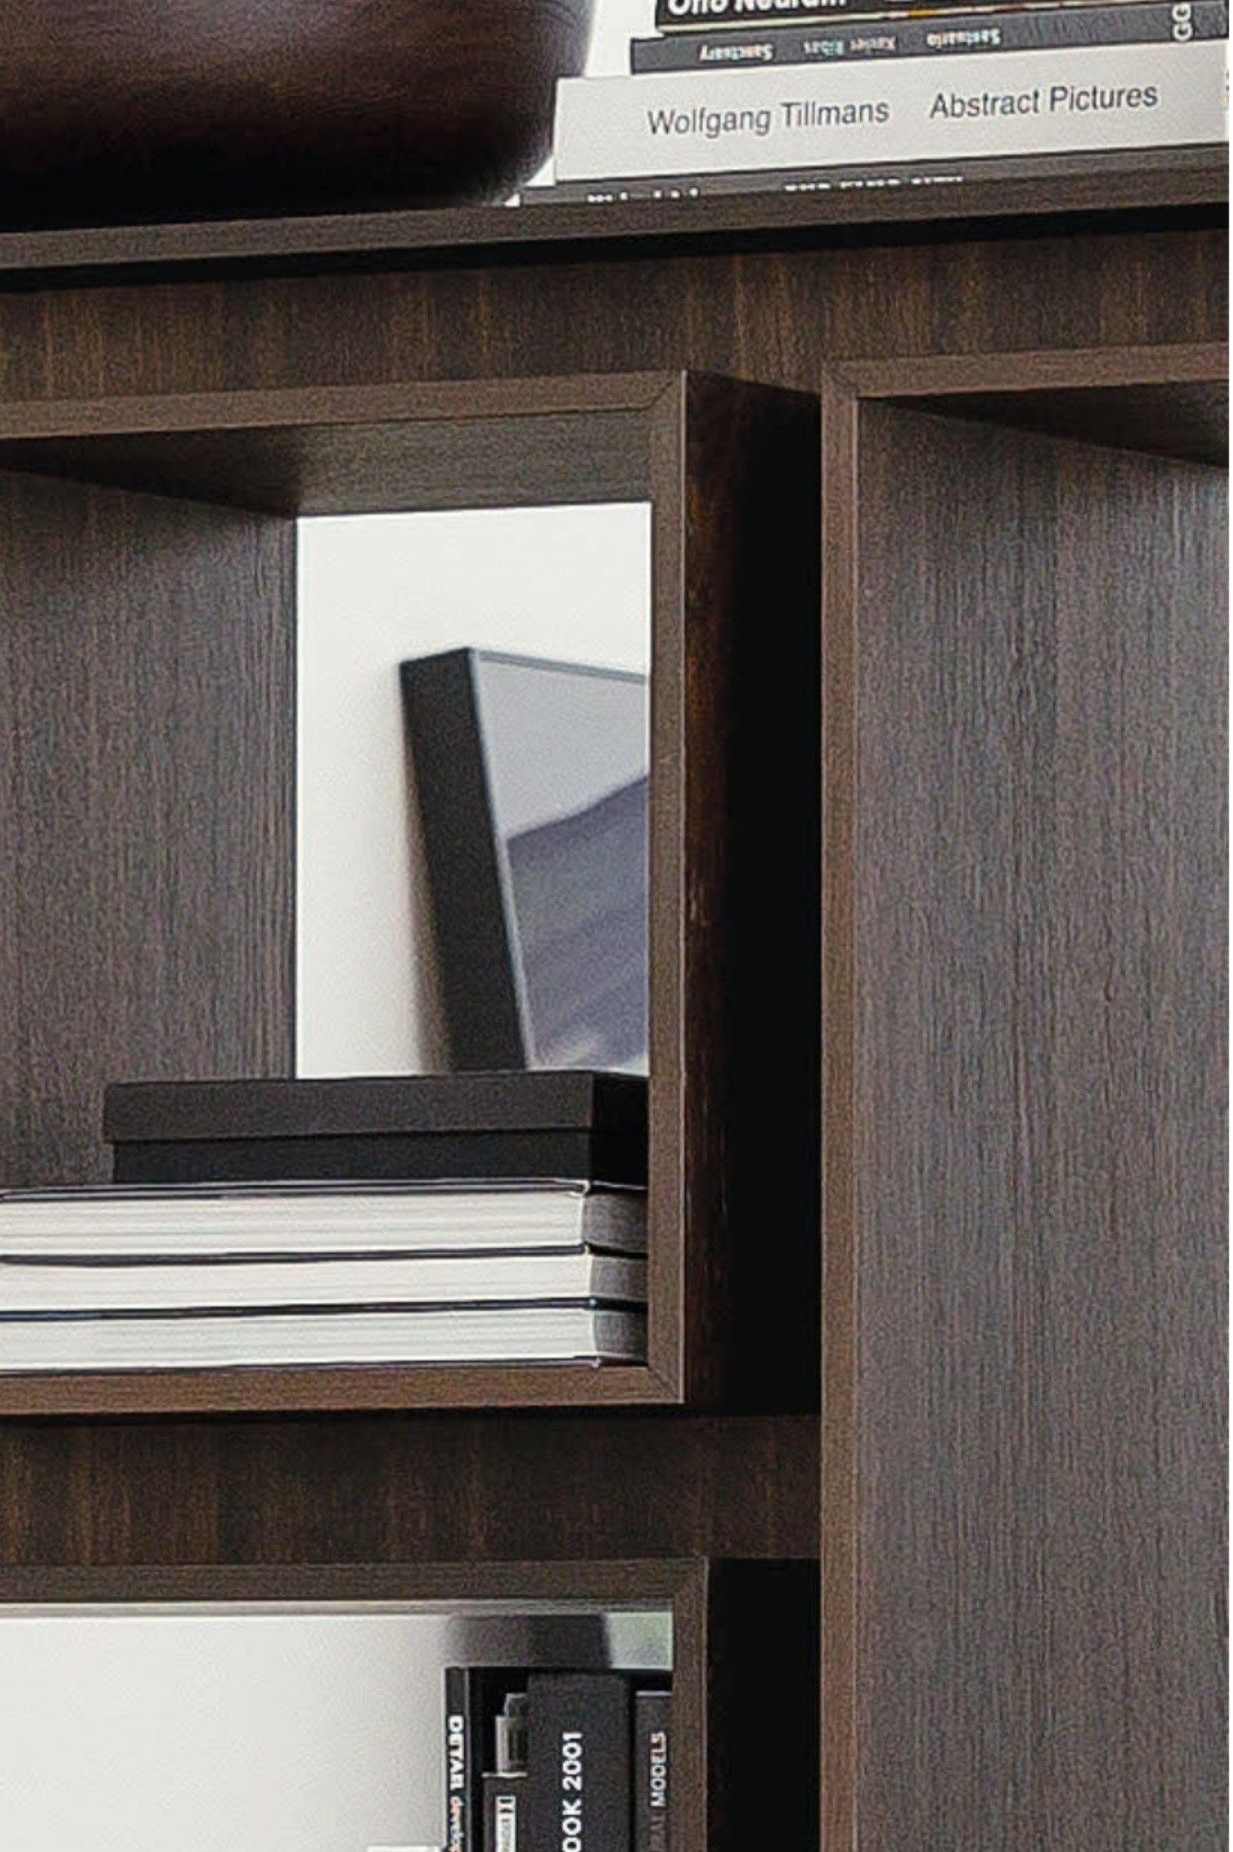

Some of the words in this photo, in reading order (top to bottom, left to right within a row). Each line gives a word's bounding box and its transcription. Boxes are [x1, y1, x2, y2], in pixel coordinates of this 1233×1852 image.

[648, 106, 771, 139] Wolfgang
[781, 101, 890, 128] Tillmans
[929, 90, 1040, 119] Abstract
[1050, 85, 1159, 112] Pictures
[562, 1731, 583, 1791] 2001
[650, 1731, 667, 1807] MODELS
